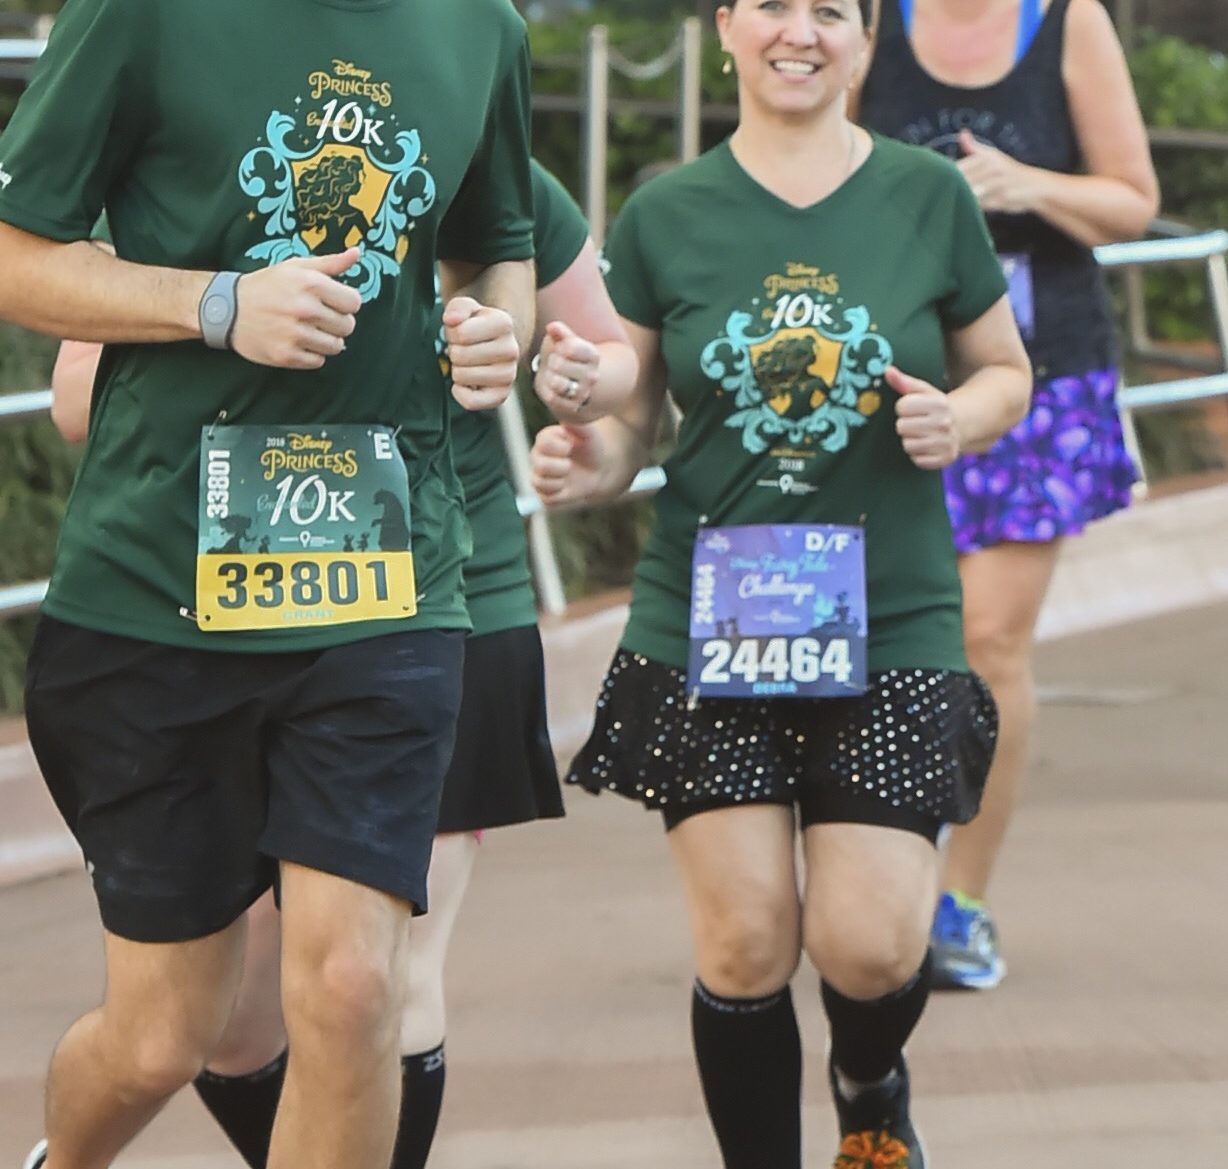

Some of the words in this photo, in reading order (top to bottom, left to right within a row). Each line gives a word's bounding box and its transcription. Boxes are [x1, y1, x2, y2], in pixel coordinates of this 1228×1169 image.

[332, 59, 371, 83] Disney
[266, 436, 285, 448] 2018
[288, 433, 332, 454] Disney
[373, 432, 394, 460] E
[206, 449, 231, 520] 33801
[805, 530, 850, 553] D/F
[216, 560, 389, 610] 33801
[738, 572, 816, 605] Challenge
[700, 637, 853, 684] 24464
